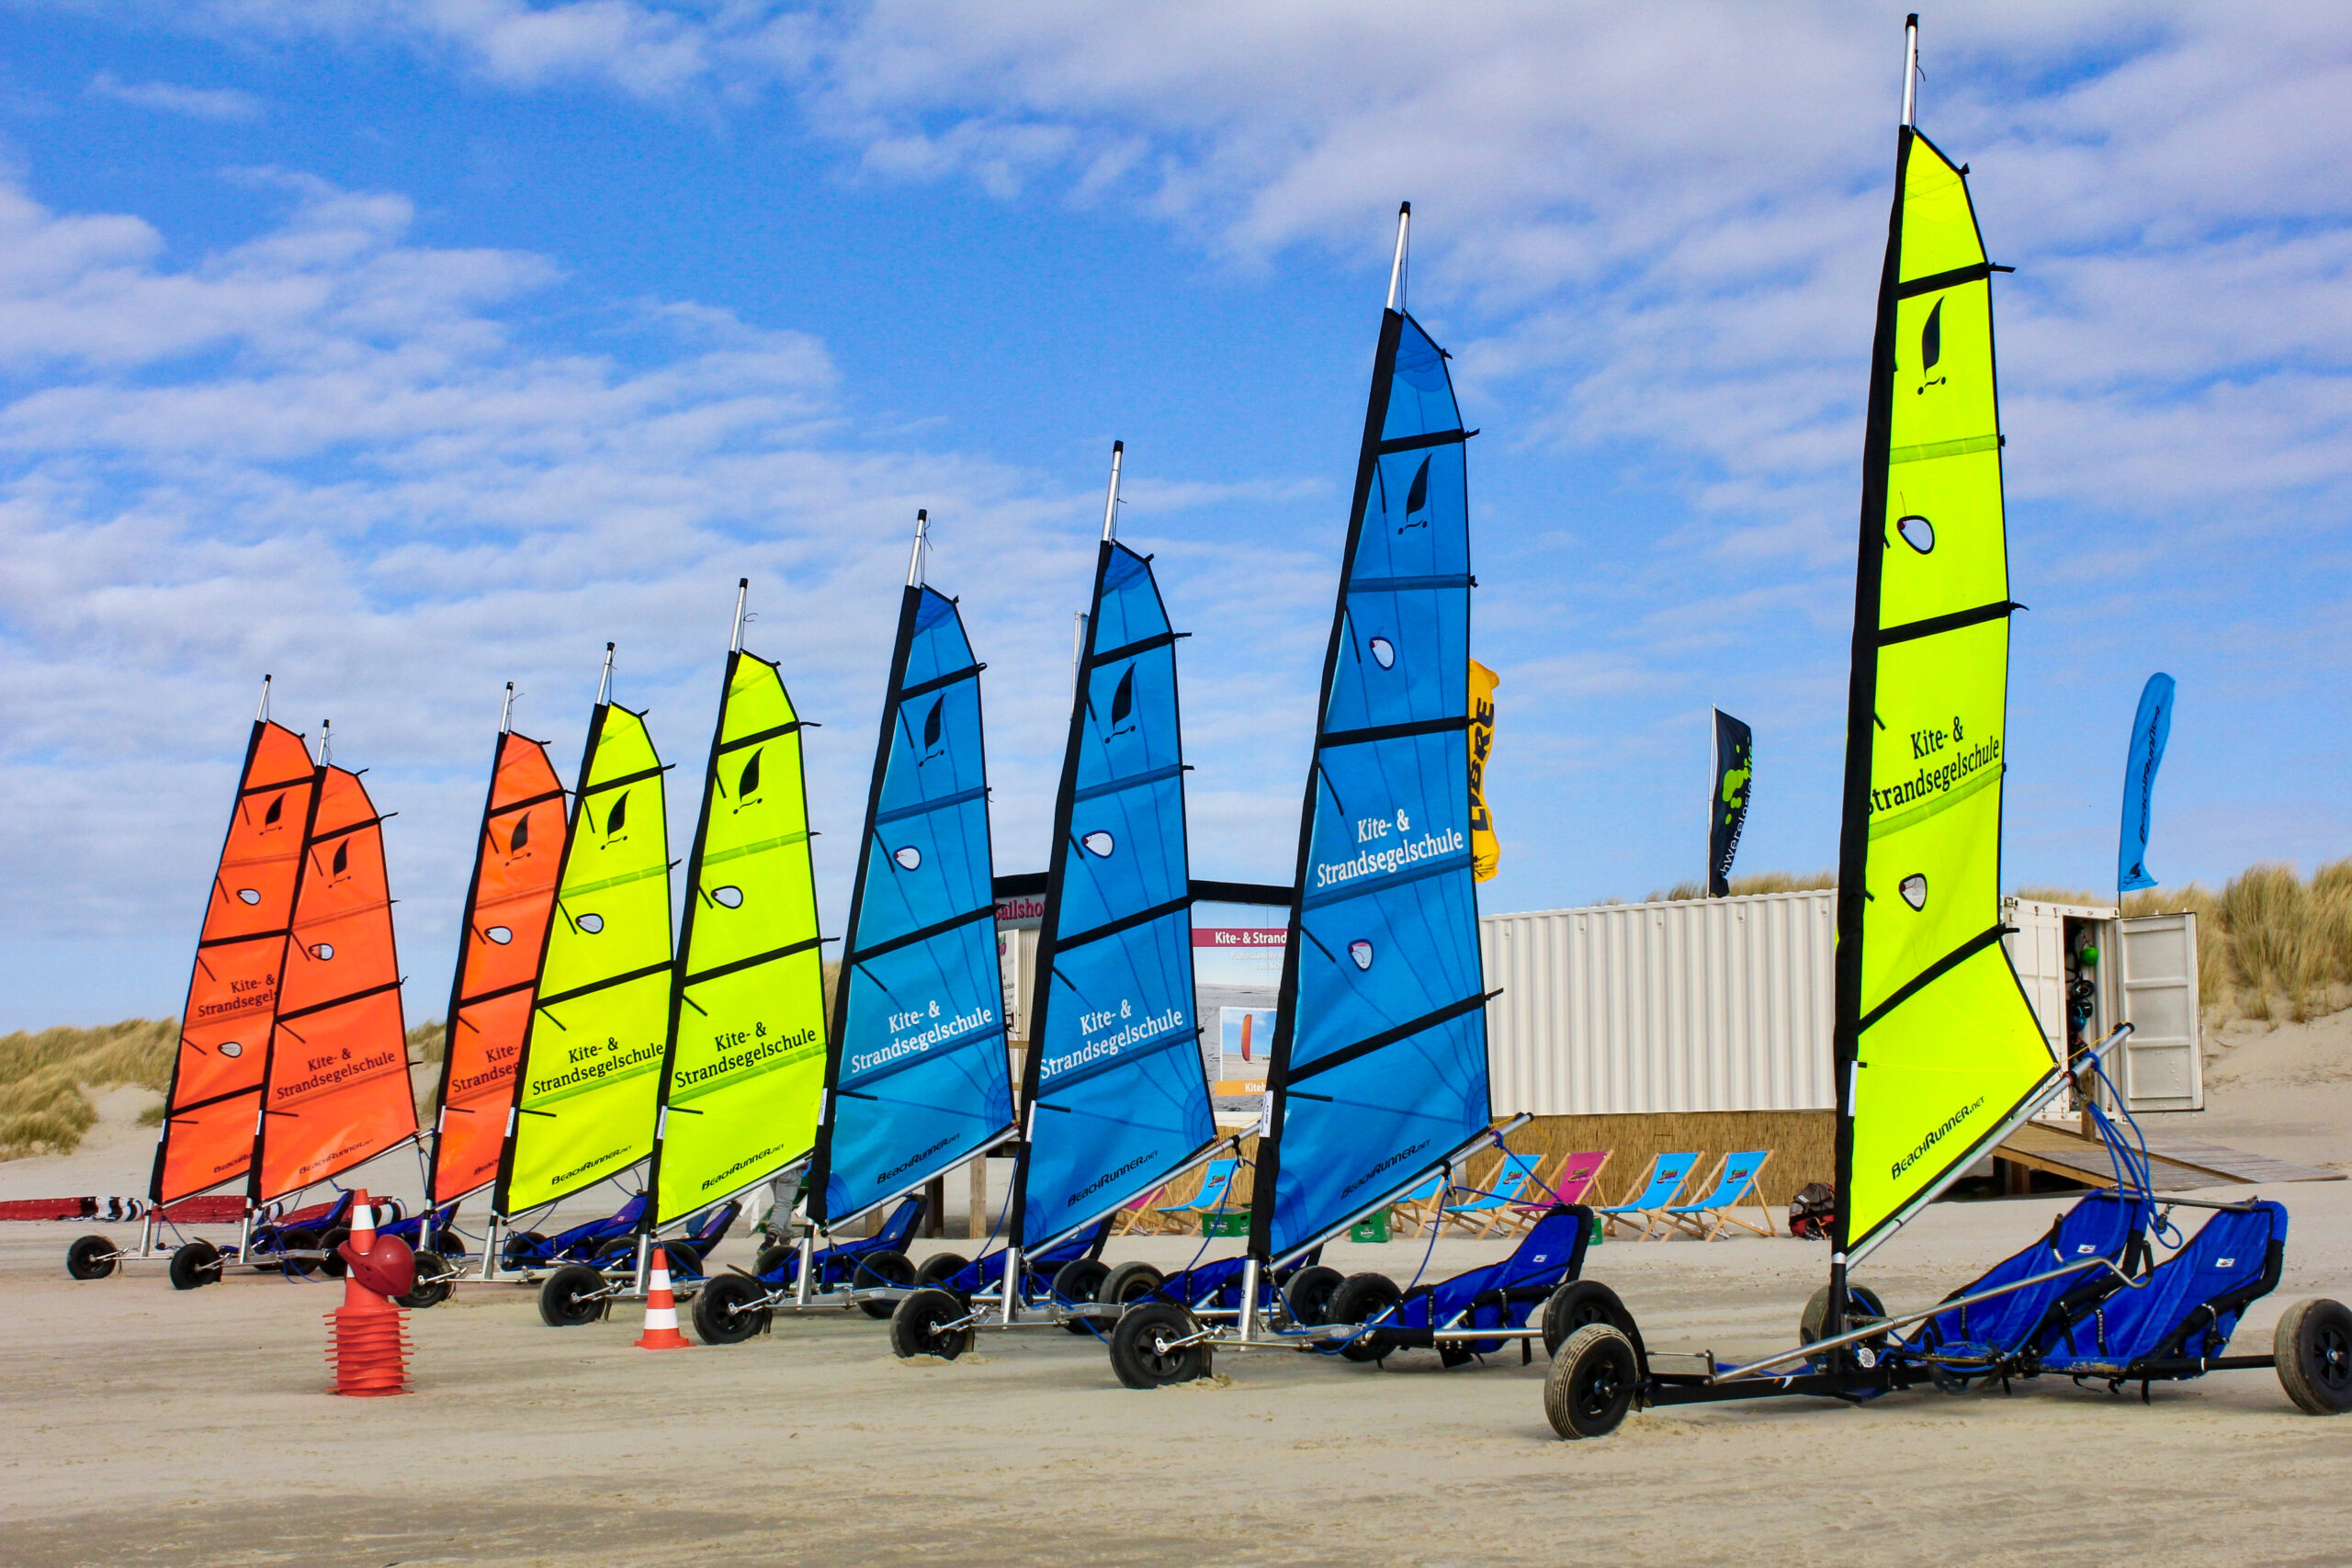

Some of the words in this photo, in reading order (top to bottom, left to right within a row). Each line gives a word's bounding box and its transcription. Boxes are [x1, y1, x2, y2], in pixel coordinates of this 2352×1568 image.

[1910, 729, 1948, 760] Kite-
[1953, 716, 1963, 742] &
[1357, 818, 1392, 843] Kite-
[1396, 808, 1410, 831] &
[1317, 828, 1464, 888] Strandsegelschule
[995, 897, 1045, 920] ailsho
[1215, 931, 1240, 944] Kite-
[1242, 931, 1251, 944] &
[231, 979, 262, 993] Kite-
[266, 974, 275, 986] &
[198, 989, 277, 1017] Strandsegel
[888, 1011, 924, 1034] Kite-
[929, 1000, 941, 1018] &
[1080, 1011, 1116, 1035] Kite-
[1120, 999, 1132, 1019] &
[568, 1044, 603, 1064] Kite-
[607, 1037, 618, 1051] &
[715, 1032, 751, 1052] Kite-
[755, 1021, 766, 1037] &
[851, 1007, 993, 1073] Strandsegelschule
[1040, 1009, 1183, 1079] Strandsegelschule
[308, 1055, 337, 1072] Kite-
[342, 1048, 351, 1060] &
[485, 1045, 518, 1063] Kite-
[533, 1043, 664, 1095] Strandsegelschule
[674, 1029, 817, 1088] Strandsegelschule
[277, 1051, 395, 1100] Strandsegelschule
